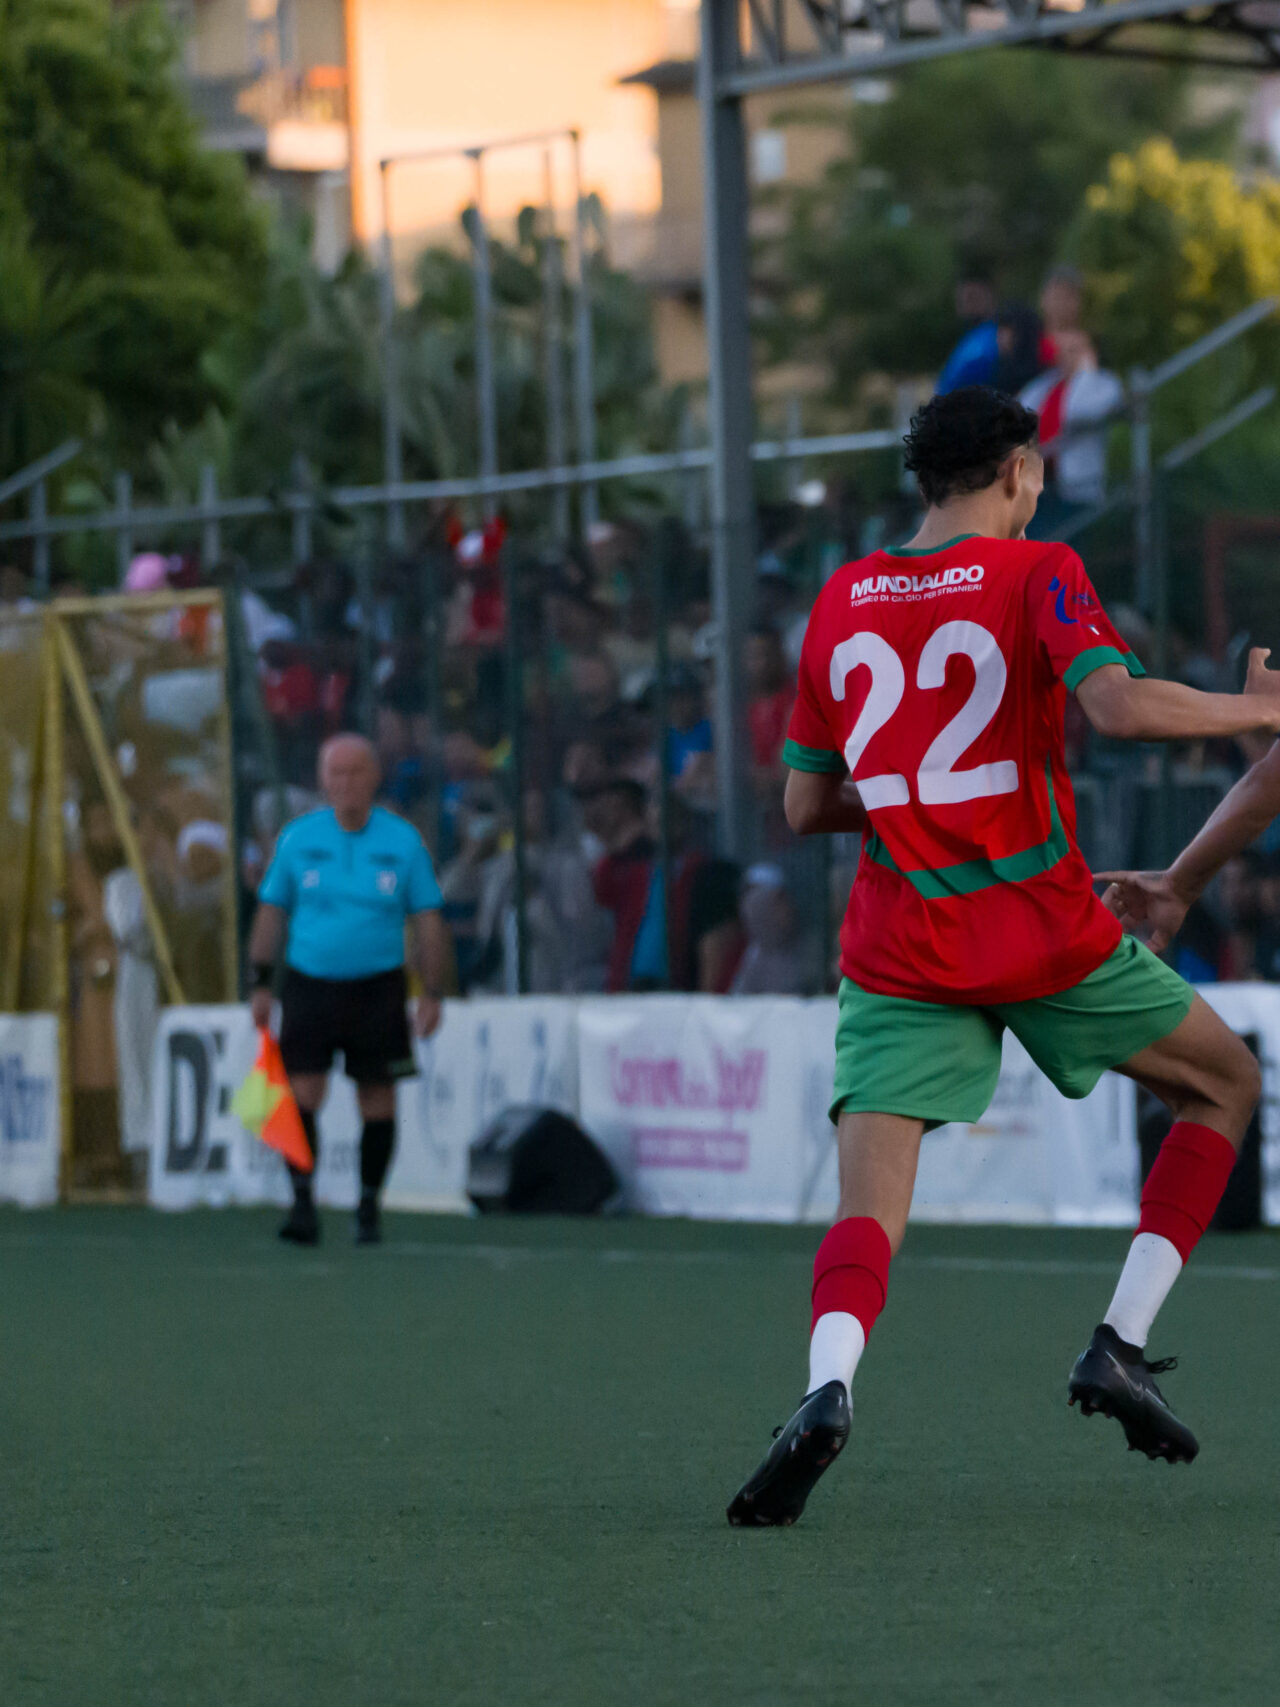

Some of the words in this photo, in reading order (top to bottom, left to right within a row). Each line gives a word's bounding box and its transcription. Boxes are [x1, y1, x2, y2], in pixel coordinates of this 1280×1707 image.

[850, 565, 985, 600] MUNDIALIDO
[880, 594, 889, 602] DI
[923, 590, 937, 600] PER
[937, 584, 982, 597] STRANIERI
[829, 619, 1019, 811] 22
